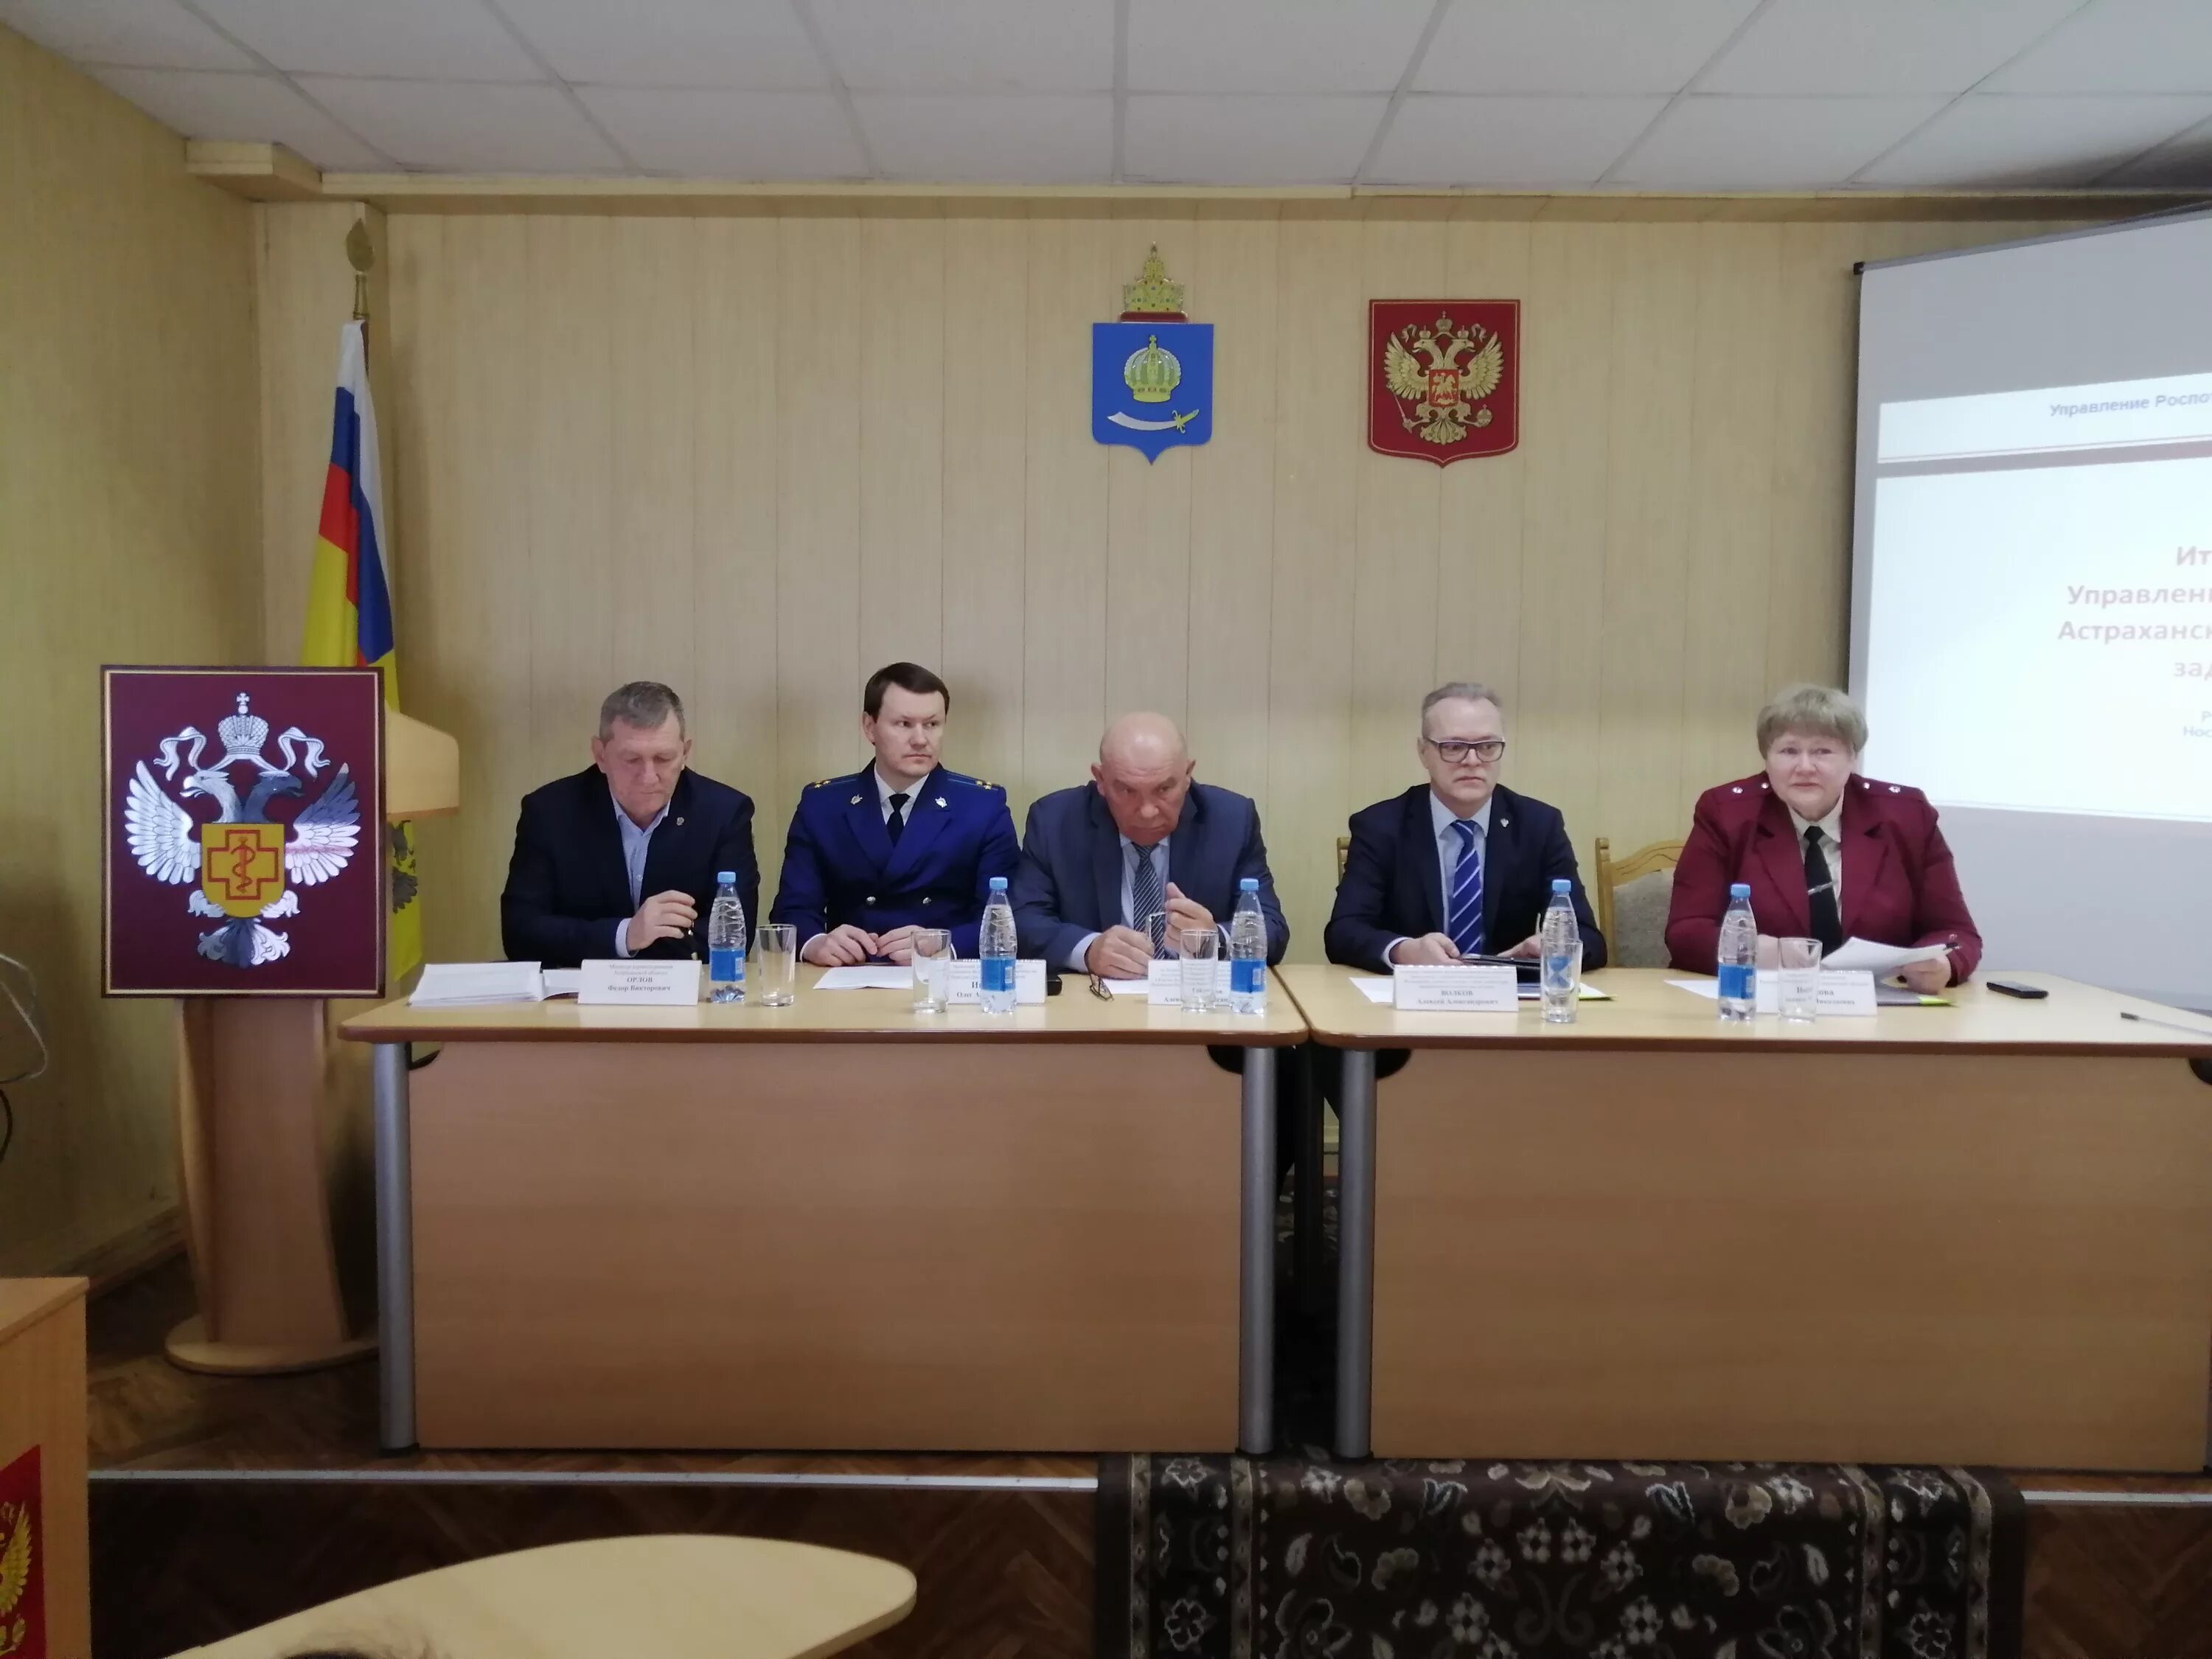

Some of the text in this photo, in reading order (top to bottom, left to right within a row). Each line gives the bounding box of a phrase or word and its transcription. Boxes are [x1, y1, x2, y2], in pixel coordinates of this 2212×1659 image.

[2050, 393, 2212, 418] Управление Роспо
[2067, 585, 2212, 609] Управлен
